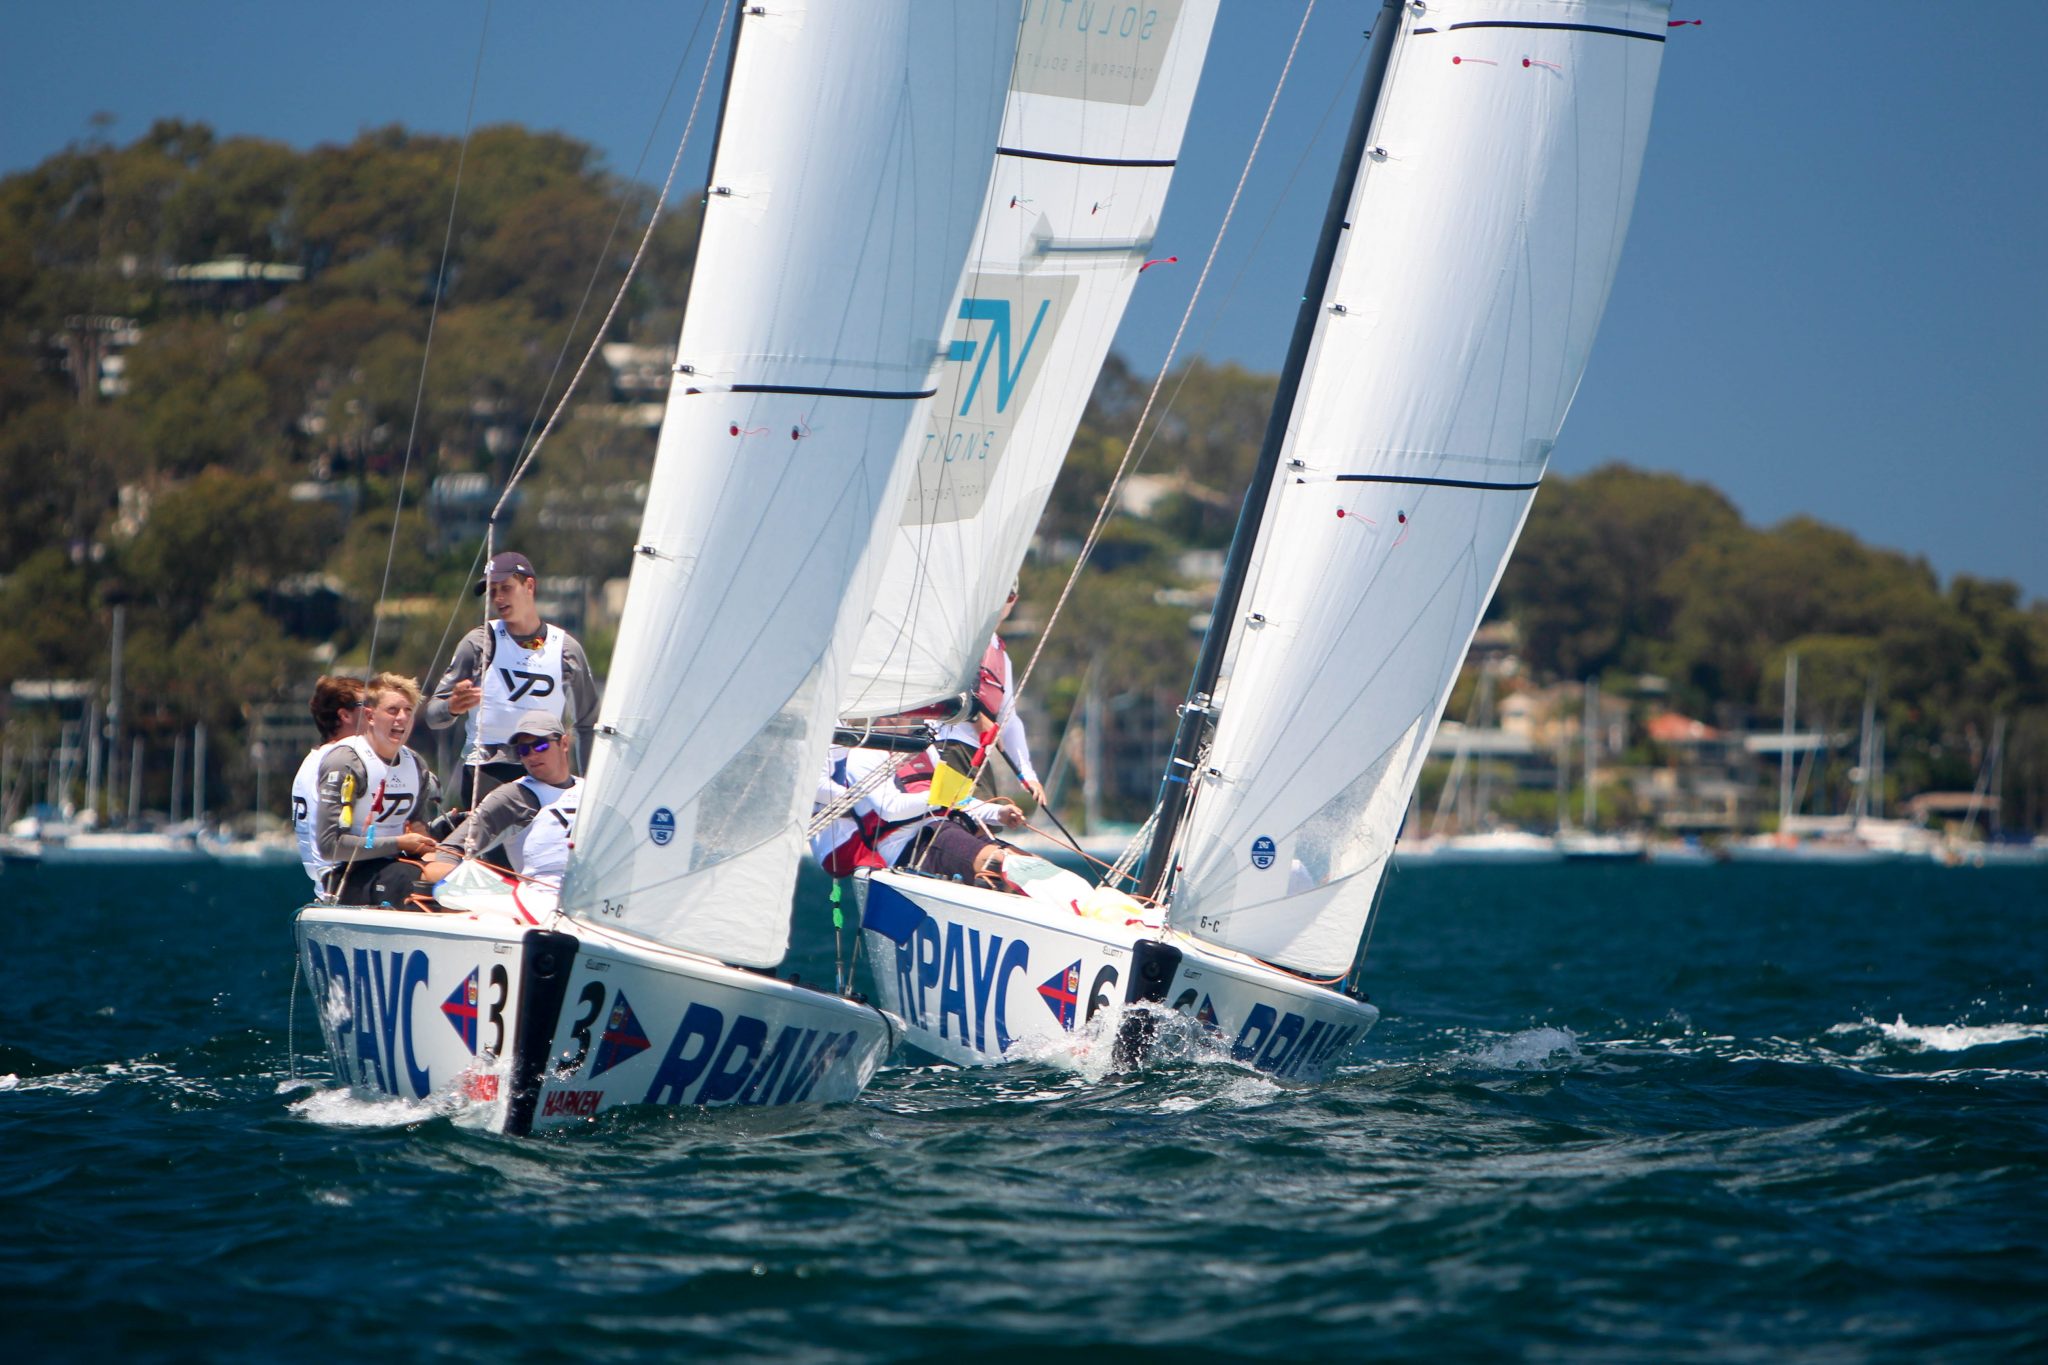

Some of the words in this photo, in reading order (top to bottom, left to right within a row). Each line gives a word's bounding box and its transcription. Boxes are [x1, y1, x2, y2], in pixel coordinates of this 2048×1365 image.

[601, 898, 624, 919] 3-C
[1200, 915, 1221, 934] 6-C
[484, 963, 509, 1064] 3
[895, 914, 1031, 1058] RPAYC
[555, 980, 607, 1077] 3
[541, 1090, 605, 1117] HARKEN
